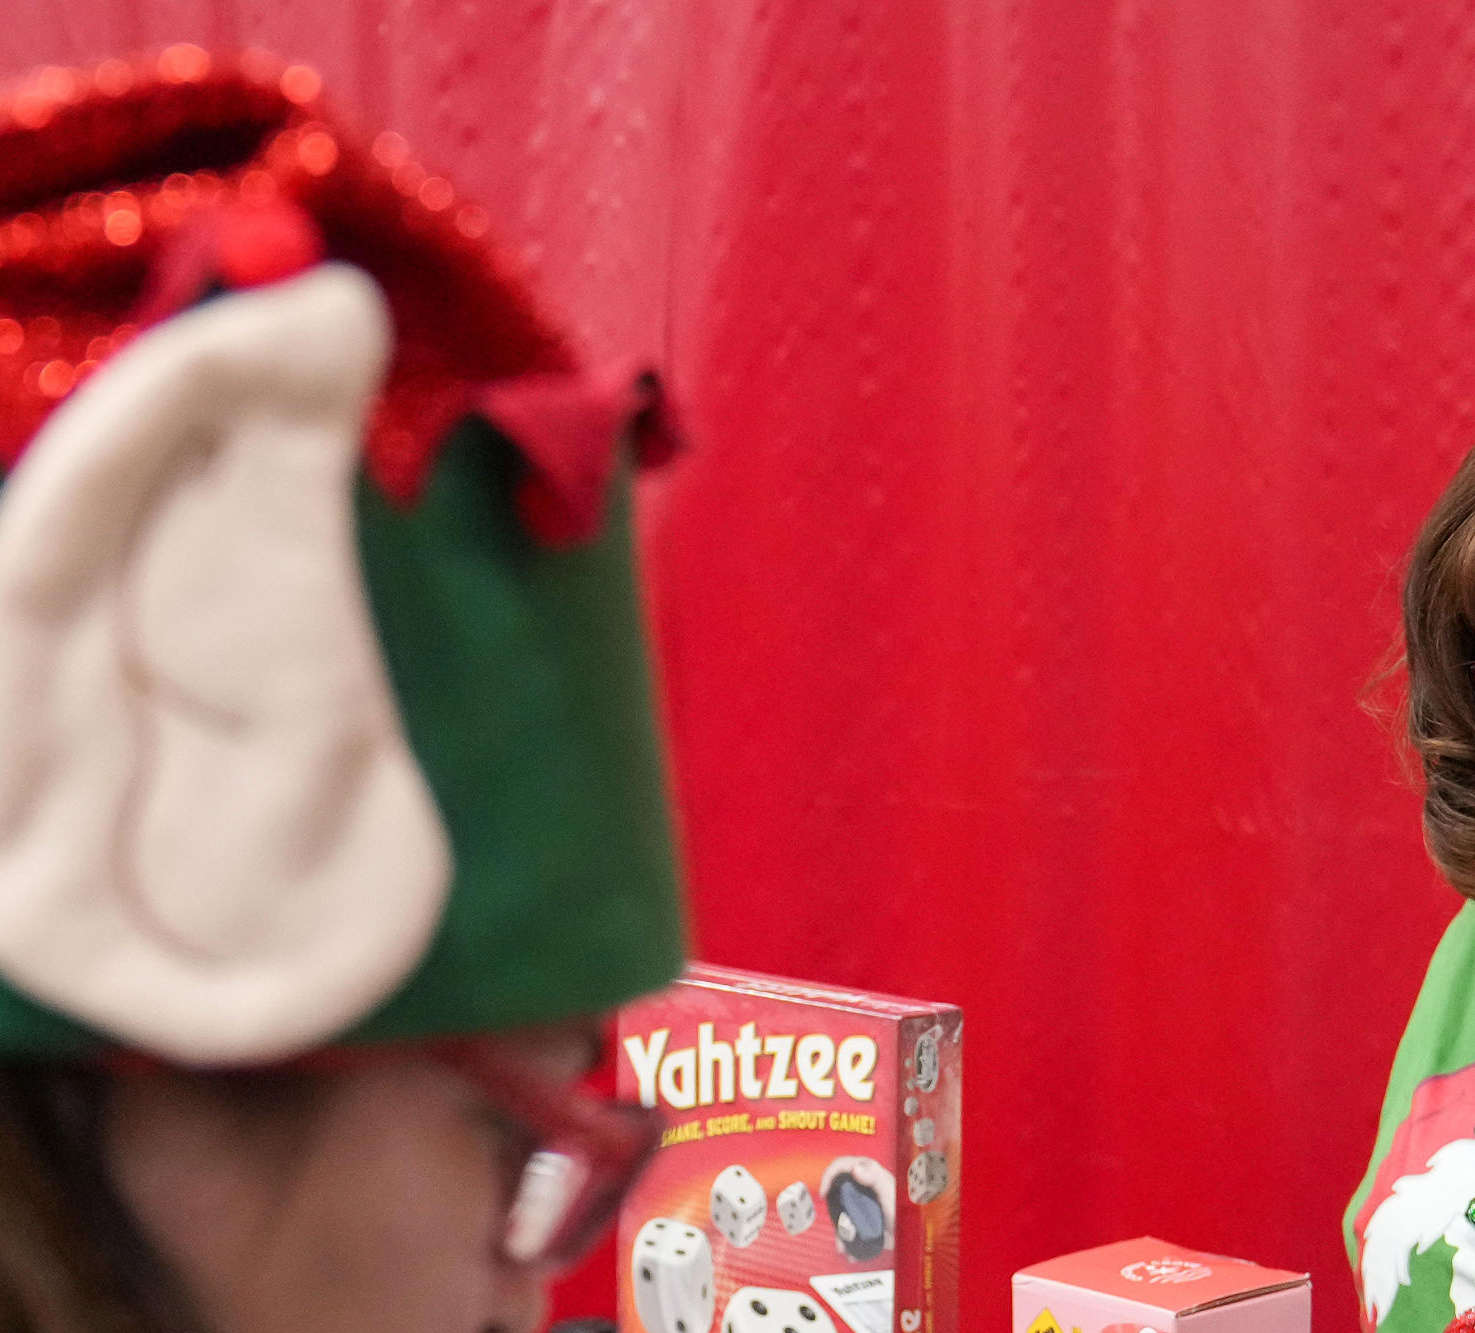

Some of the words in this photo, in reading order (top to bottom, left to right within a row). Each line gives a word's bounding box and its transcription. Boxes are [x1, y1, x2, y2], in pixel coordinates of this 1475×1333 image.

[624, 1022, 876, 1107] Yahtzee
[778, 1111, 826, 1130] SHOUT
[830, 1111, 876, 1134] GAME!
